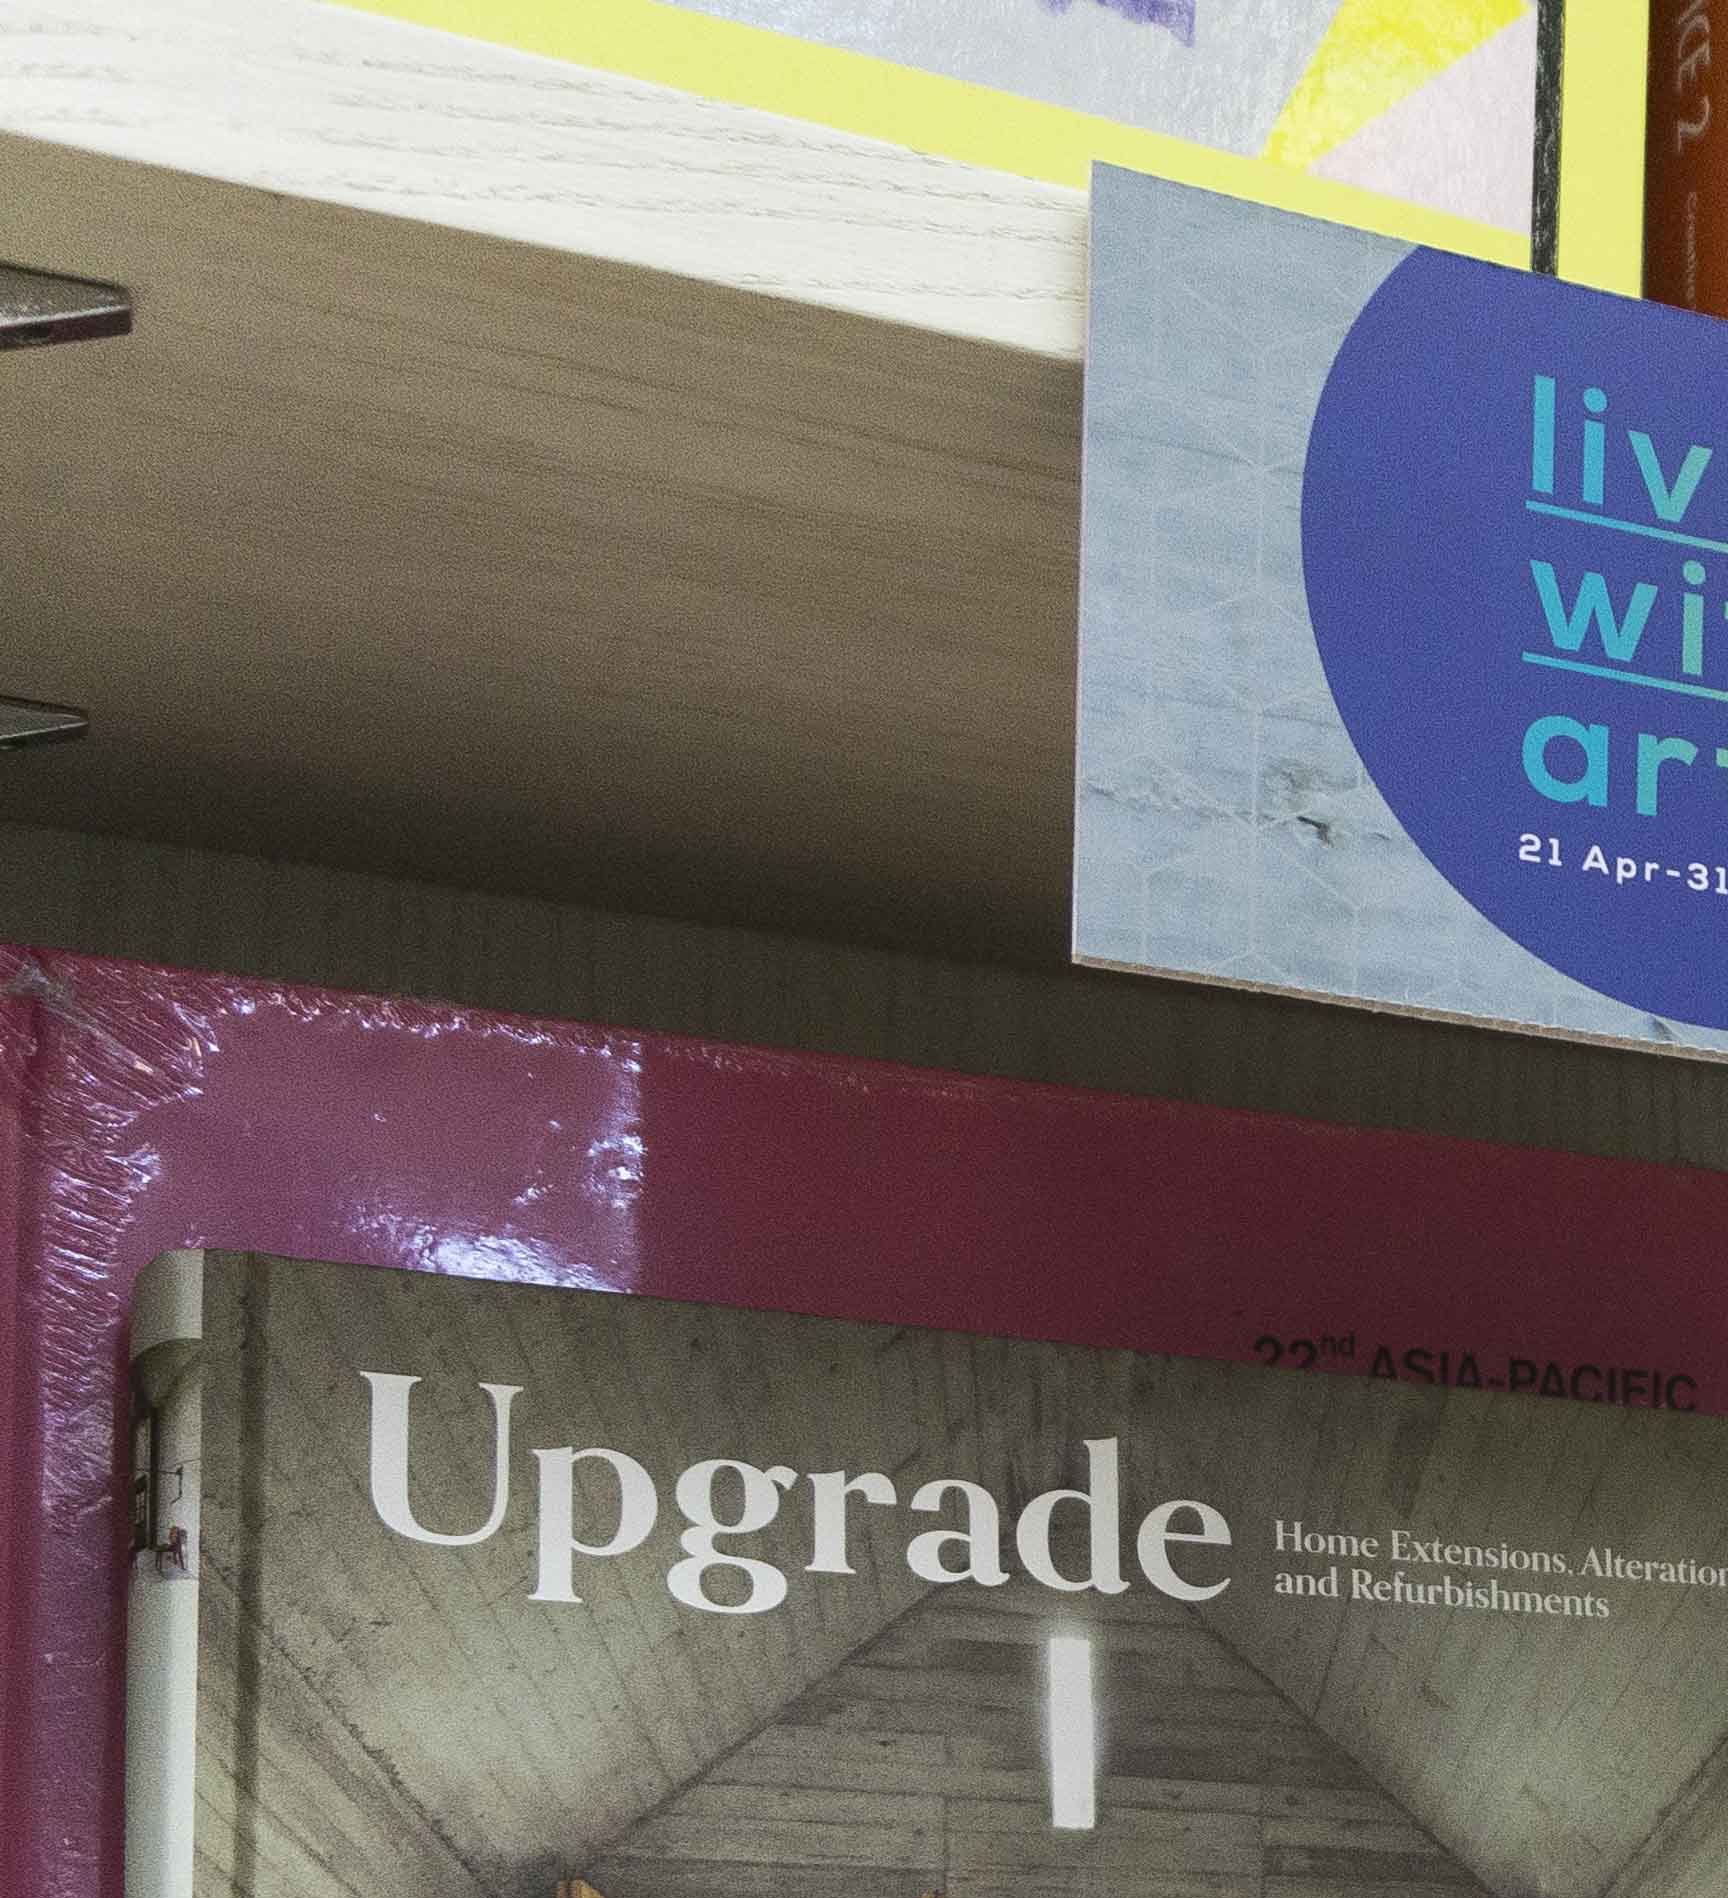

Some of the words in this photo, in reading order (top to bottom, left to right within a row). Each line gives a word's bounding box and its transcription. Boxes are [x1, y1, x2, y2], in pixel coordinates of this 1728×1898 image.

[1518, 833, 1564, 868] 21
[1370, 1344, 1698, 1412] ASIA-PACIFIC
[360, 1370, 1232, 1615] Upgrade
[1275, 1519, 1379, 1558] Home
[1275, 1566, 1339, 1598] and
[1351, 1568, 1610, 1618] Refurbishments
